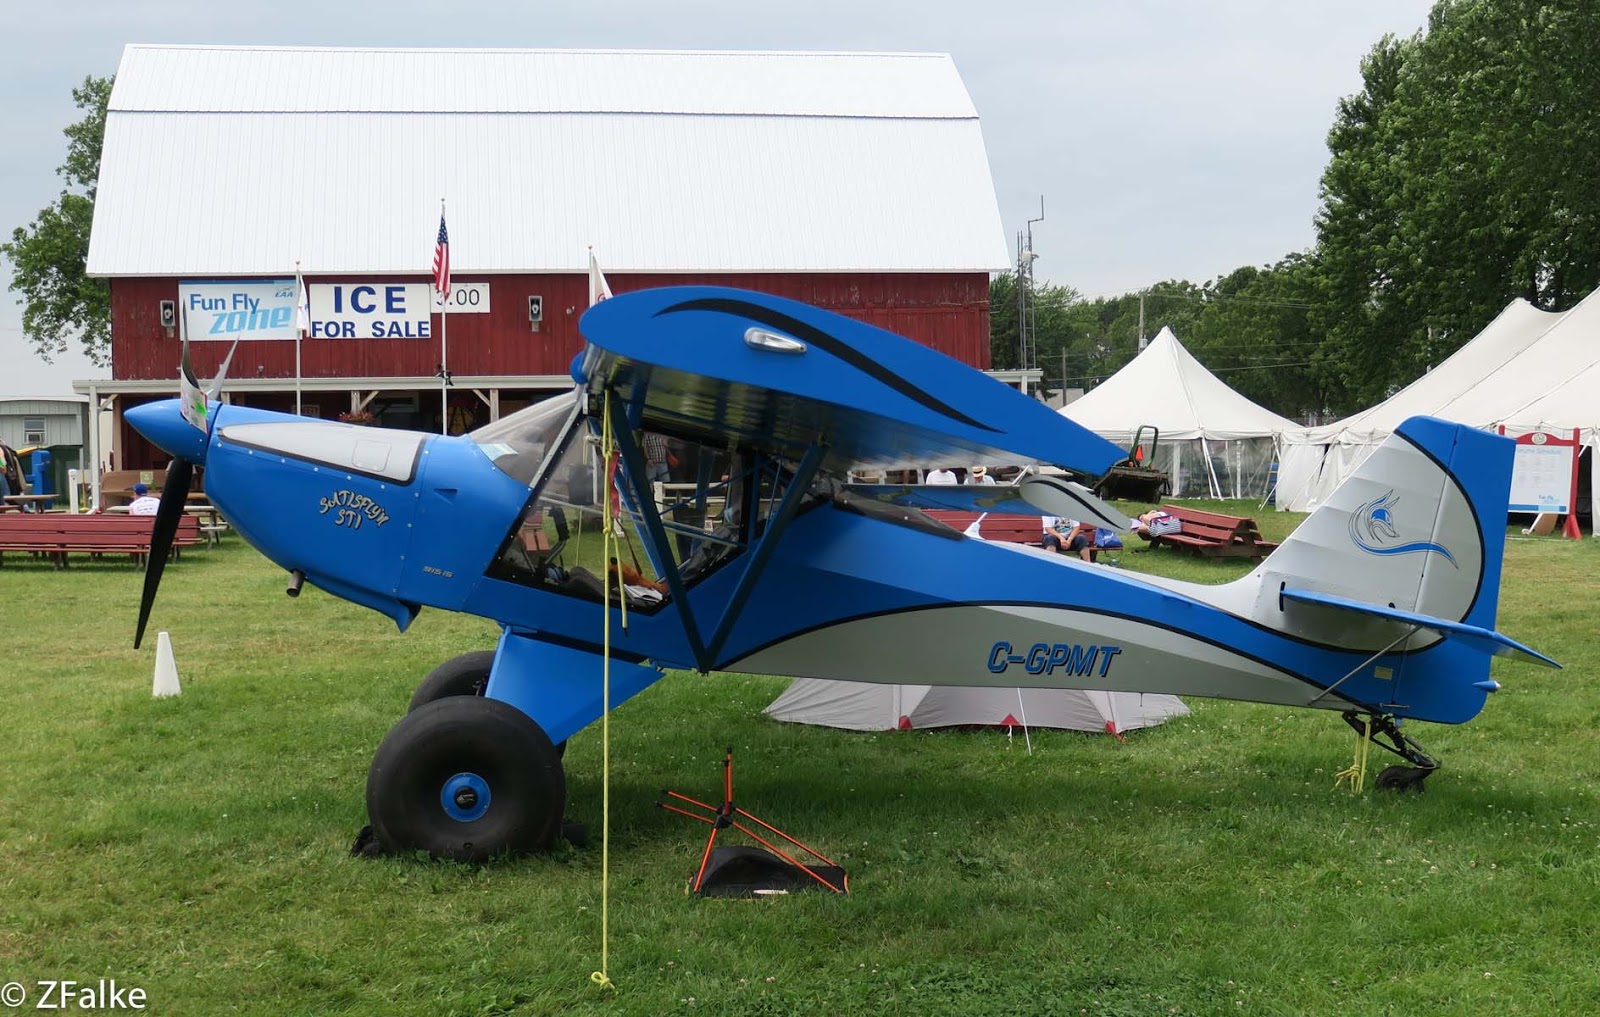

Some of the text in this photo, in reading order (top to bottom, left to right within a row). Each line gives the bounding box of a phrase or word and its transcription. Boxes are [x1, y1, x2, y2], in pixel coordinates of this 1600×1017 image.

[190, 293, 260, 315] Fun Fly
[333, 285, 407, 314] ICE
[209, 306, 293, 335] zone
[311, 320, 430, 338] FOR SALE
[987, 641, 1123, 678] C-GPMT
